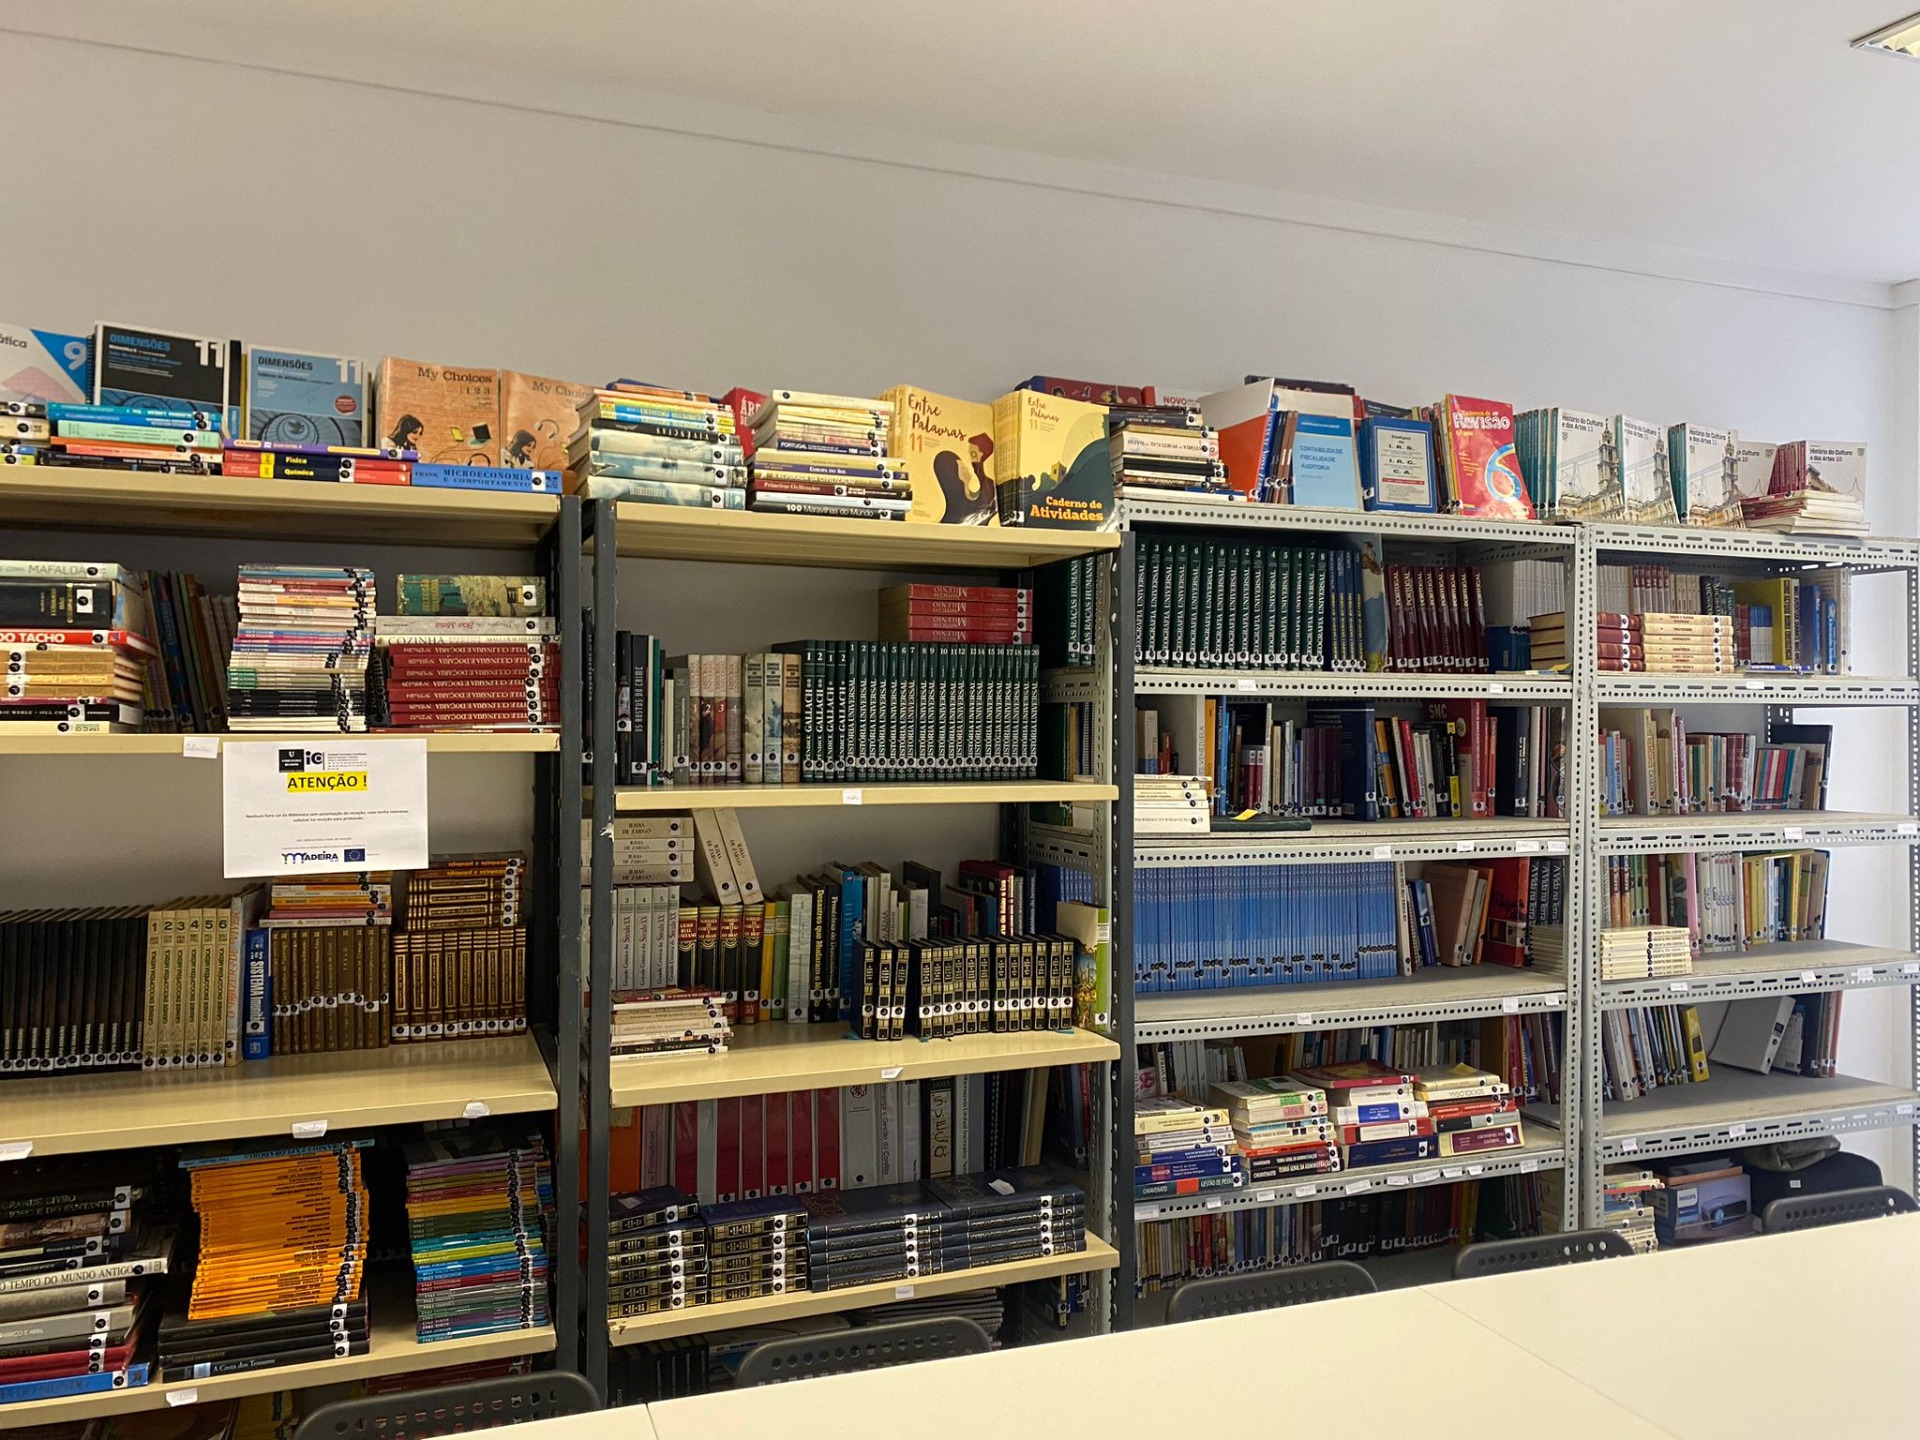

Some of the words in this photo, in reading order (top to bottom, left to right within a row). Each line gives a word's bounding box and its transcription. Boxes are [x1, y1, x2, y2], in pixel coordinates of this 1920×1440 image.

[109, 333, 171, 351] DIMENSÕES
[64, 341, 87, 371] 9
[195, 340, 223, 368] 11
[258, 356, 313, 371] DIMENSÕES
[336, 359, 362, 385] 11
[418, 366, 438, 382] My
[443, 371, 492, 384] Choices
[532, 381, 551, 395] My
[908, 393, 941, 417] Entre
[1028, 397, 1047, 410] Entre
[1163, 396, 1186, 404] NOVO
[1030, 408, 1060, 423] Palavras
[1453, 411, 1510, 430] Revisão
[912, 413, 967, 441] Palavras
[1300, 445, 1343, 454] CONTABILIDADE
[1300, 454, 1335, 462] FISCALIDADE
[1301, 463, 1330, 471] AUDITORIA
[443, 468, 530, 481] MICROECONOMIA
[454, 478, 531, 488] COMPORTAMENTO
[1046, 497, 1087, 509] Caderno
[1090, 500, 1102, 509] de
[850, 509, 873, 517] Mundo
[1030, 505, 1104, 521] Atividades
[28, 565, 87, 576] MAFALDA
[1137, 563, 1145, 607] UNIVERSAL
[1405, 571, 1413, 606] PORTUGAL
[19, 632, 65, 643] TACHO
[807, 652, 811, 661] 1
[818, 652, 823, 661] 2
[848, 678, 856, 722] UNIVERSAL
[927, 680, 935, 723] UNIVERSAL
[805, 689, 813, 732] GALLACH
[1429, 704, 1448, 719] SNC
[288, 774, 357, 790] ATENÇÃO
[364, 775, 366, 787] !
[1553, 865, 1560, 873] A
[1552, 874, 1561, 890] Vida
[1553, 891, 1559, 900] na
[816, 890, 824, 924] Desastres
[1551, 901, 1560, 919] Terra
[164, 921, 173, 931] 2
[176, 921, 185, 931] 3
[190, 920, 199, 930] 4
[205, 920, 213, 930] 5
[218, 920, 227, 929] 6
[624, 916, 630, 924] XX
[152, 922, 158, 932] 1
[250, 961, 265, 996] SISTEMA
[1253, 1169, 1277, 1178] CHIAVENATO
[1143, 1186, 1167, 1194] CHIAVENATO
[1201, 1179, 1215, 1188] GESTÃO
[1679, 1194, 1697, 1202] PHILIPS
[10, 1279, 41, 1290] TEMPO
[44, 1275, 57, 1285] DO
[61, 1270, 96, 1282] MUNDO
[100, 1265, 133, 1277] ANTIGO
[219, 1363, 237, 1372] Costa
[238, 1361, 248, 1369] dos
[250, 1358, 275, 1368] Tesouros
